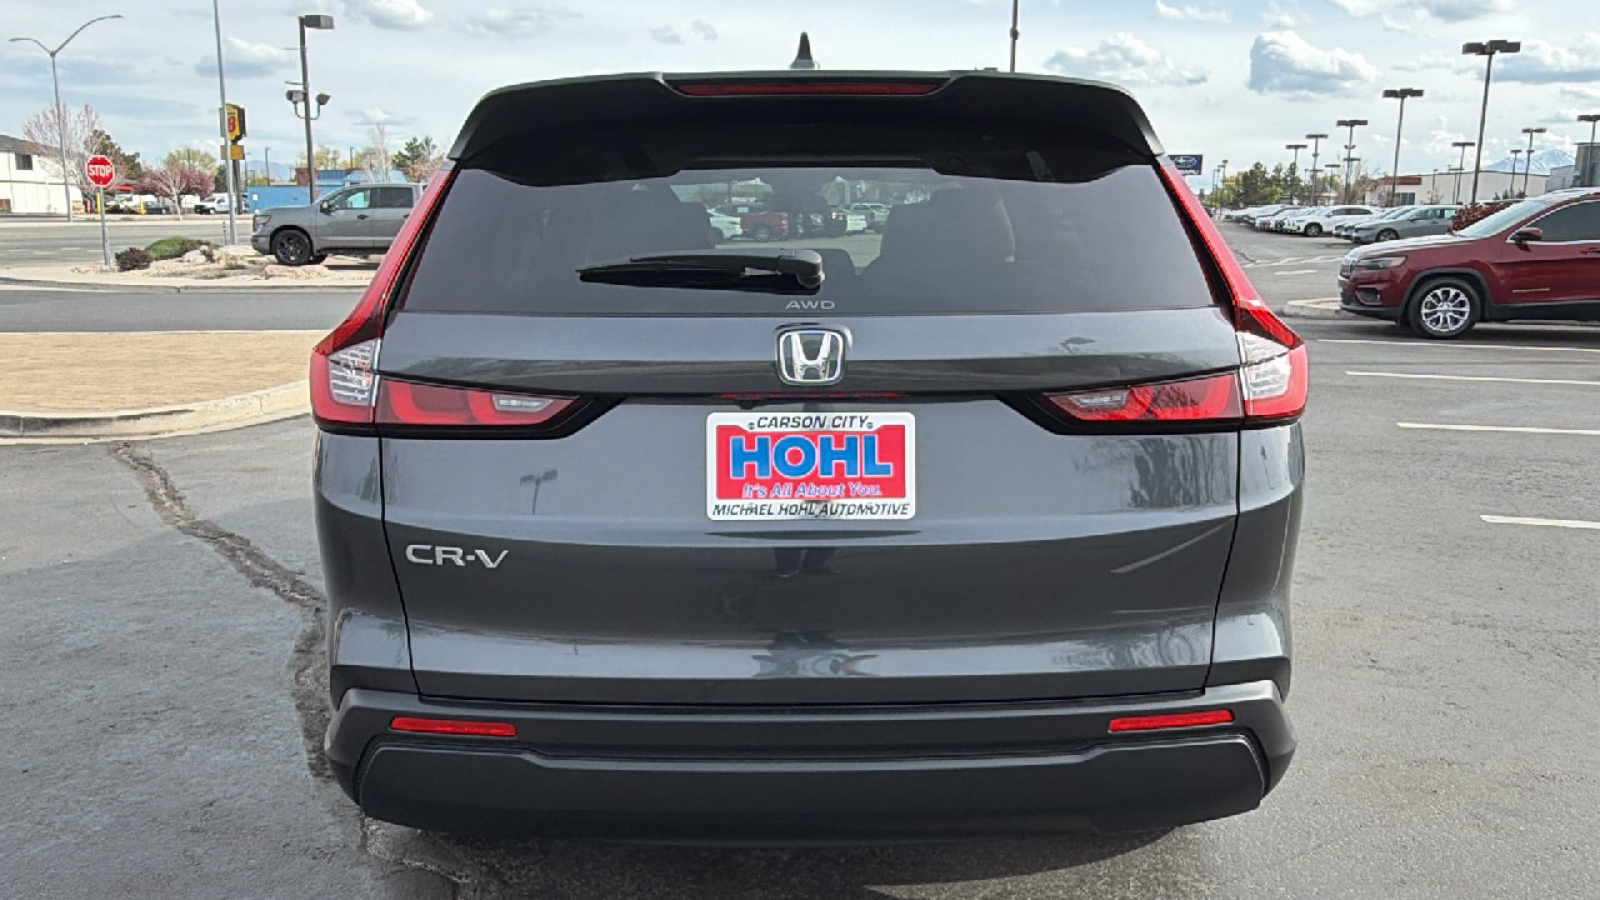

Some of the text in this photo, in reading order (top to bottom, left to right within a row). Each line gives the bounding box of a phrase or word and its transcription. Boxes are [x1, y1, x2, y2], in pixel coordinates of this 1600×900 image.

[88, 164, 112, 177] STOP
[785, 300, 835, 310] AWD
[757, 415, 869, 429] CARSON CITY
[729, 434, 894, 479] HOHL
[742, 484, 766, 498] It's
[770, 483, 792, 498] All
[796, 482, 845, 497] About
[712, 503, 910, 517] MICHAEL HOHL AUTOMOTIVE
[405, 544, 509, 569] CR-V
